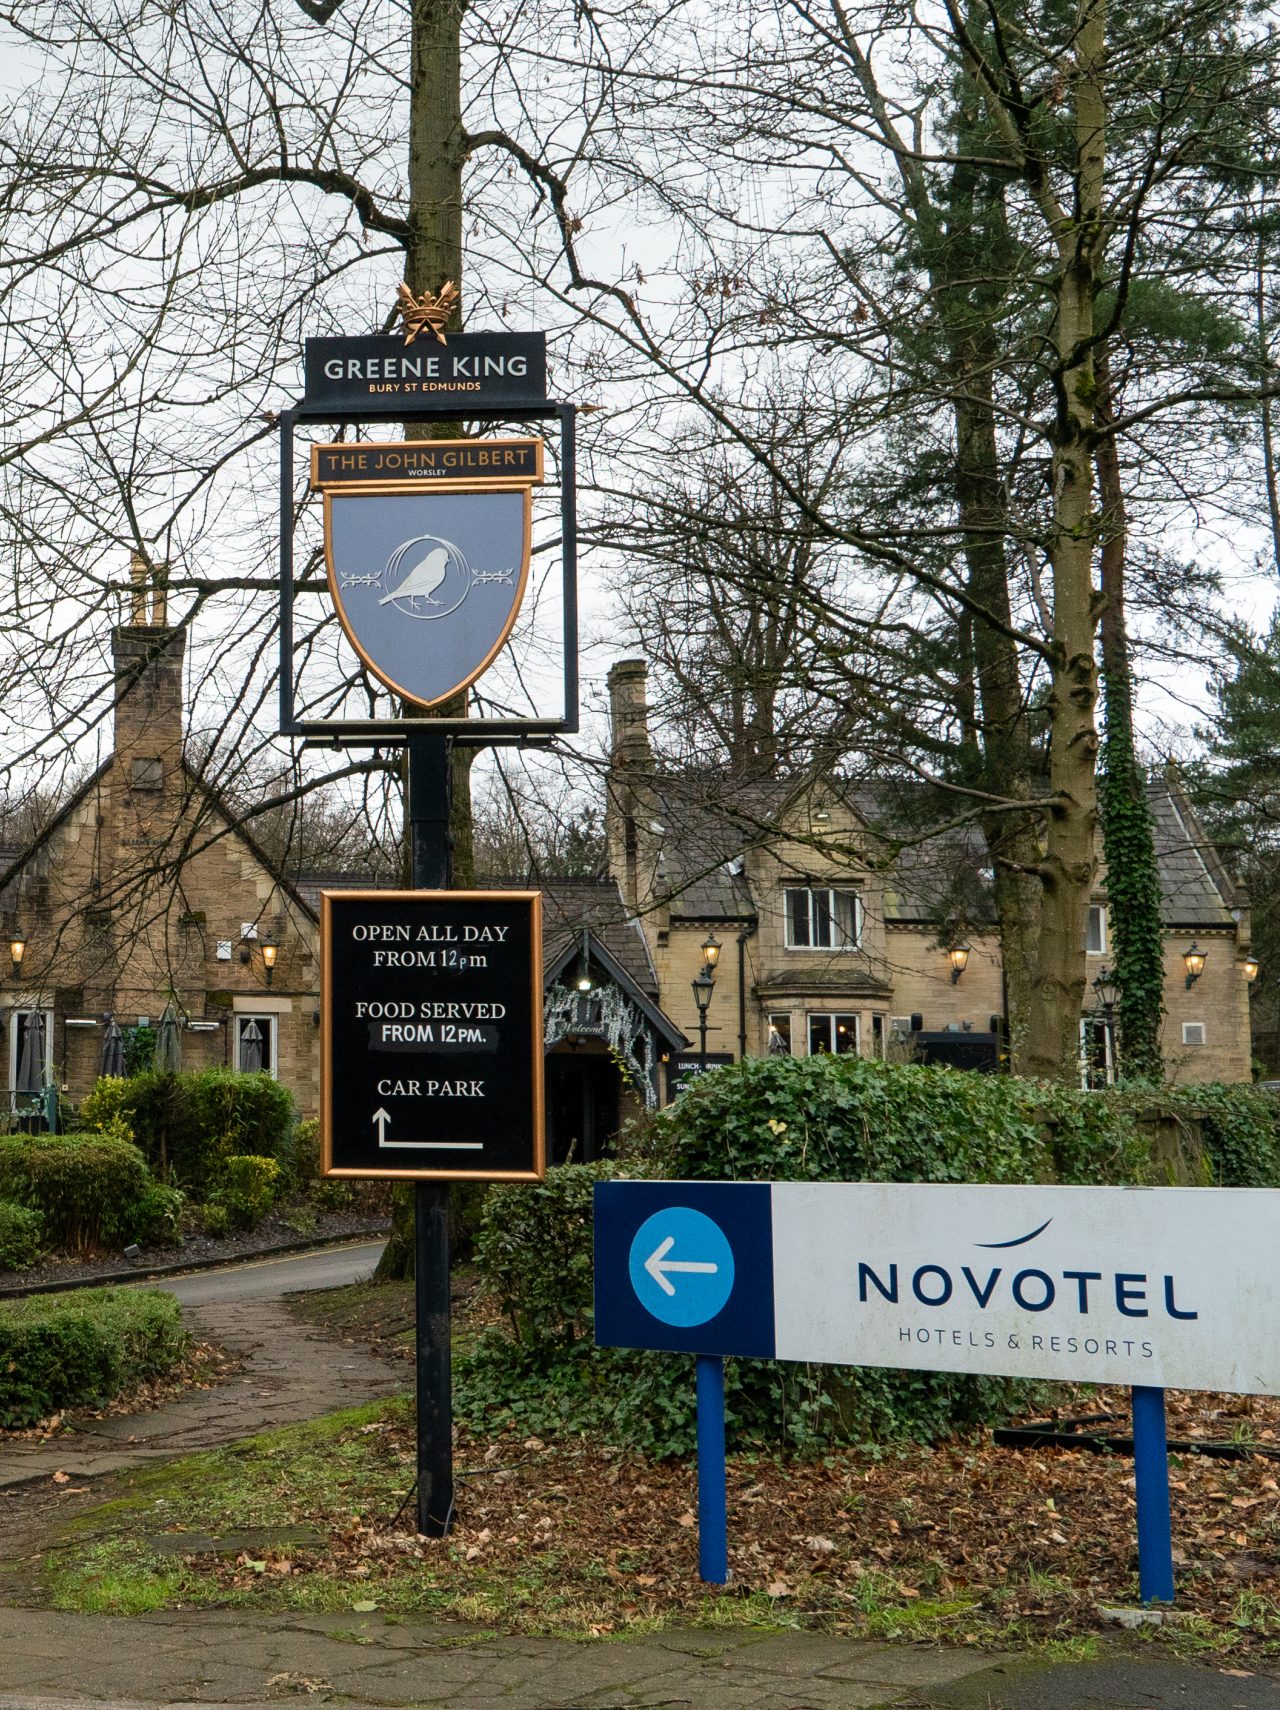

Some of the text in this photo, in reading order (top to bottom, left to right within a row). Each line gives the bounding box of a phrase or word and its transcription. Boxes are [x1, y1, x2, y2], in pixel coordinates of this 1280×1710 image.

[324, 356, 528, 380] GREENE KING
[369, 382, 481, 393] BURY ST EDMUNDS
[327, 450, 529, 470] THE JOHN GILBERT
[352, 925, 509, 942] OPEN ALL DAY
[373, 951, 437, 967] FROM
[355, 1002, 506, 1019] FOOD SERVED
[382, 1025, 434, 1042] FROM
[559, 1021, 605, 1033] Welcome
[377, 1080, 485, 1097] CAR PARK
[857, 1262, 1199, 1320] NOVOTEL
[898, 1327, 1154, 1358] HOTELS & RESORTS
